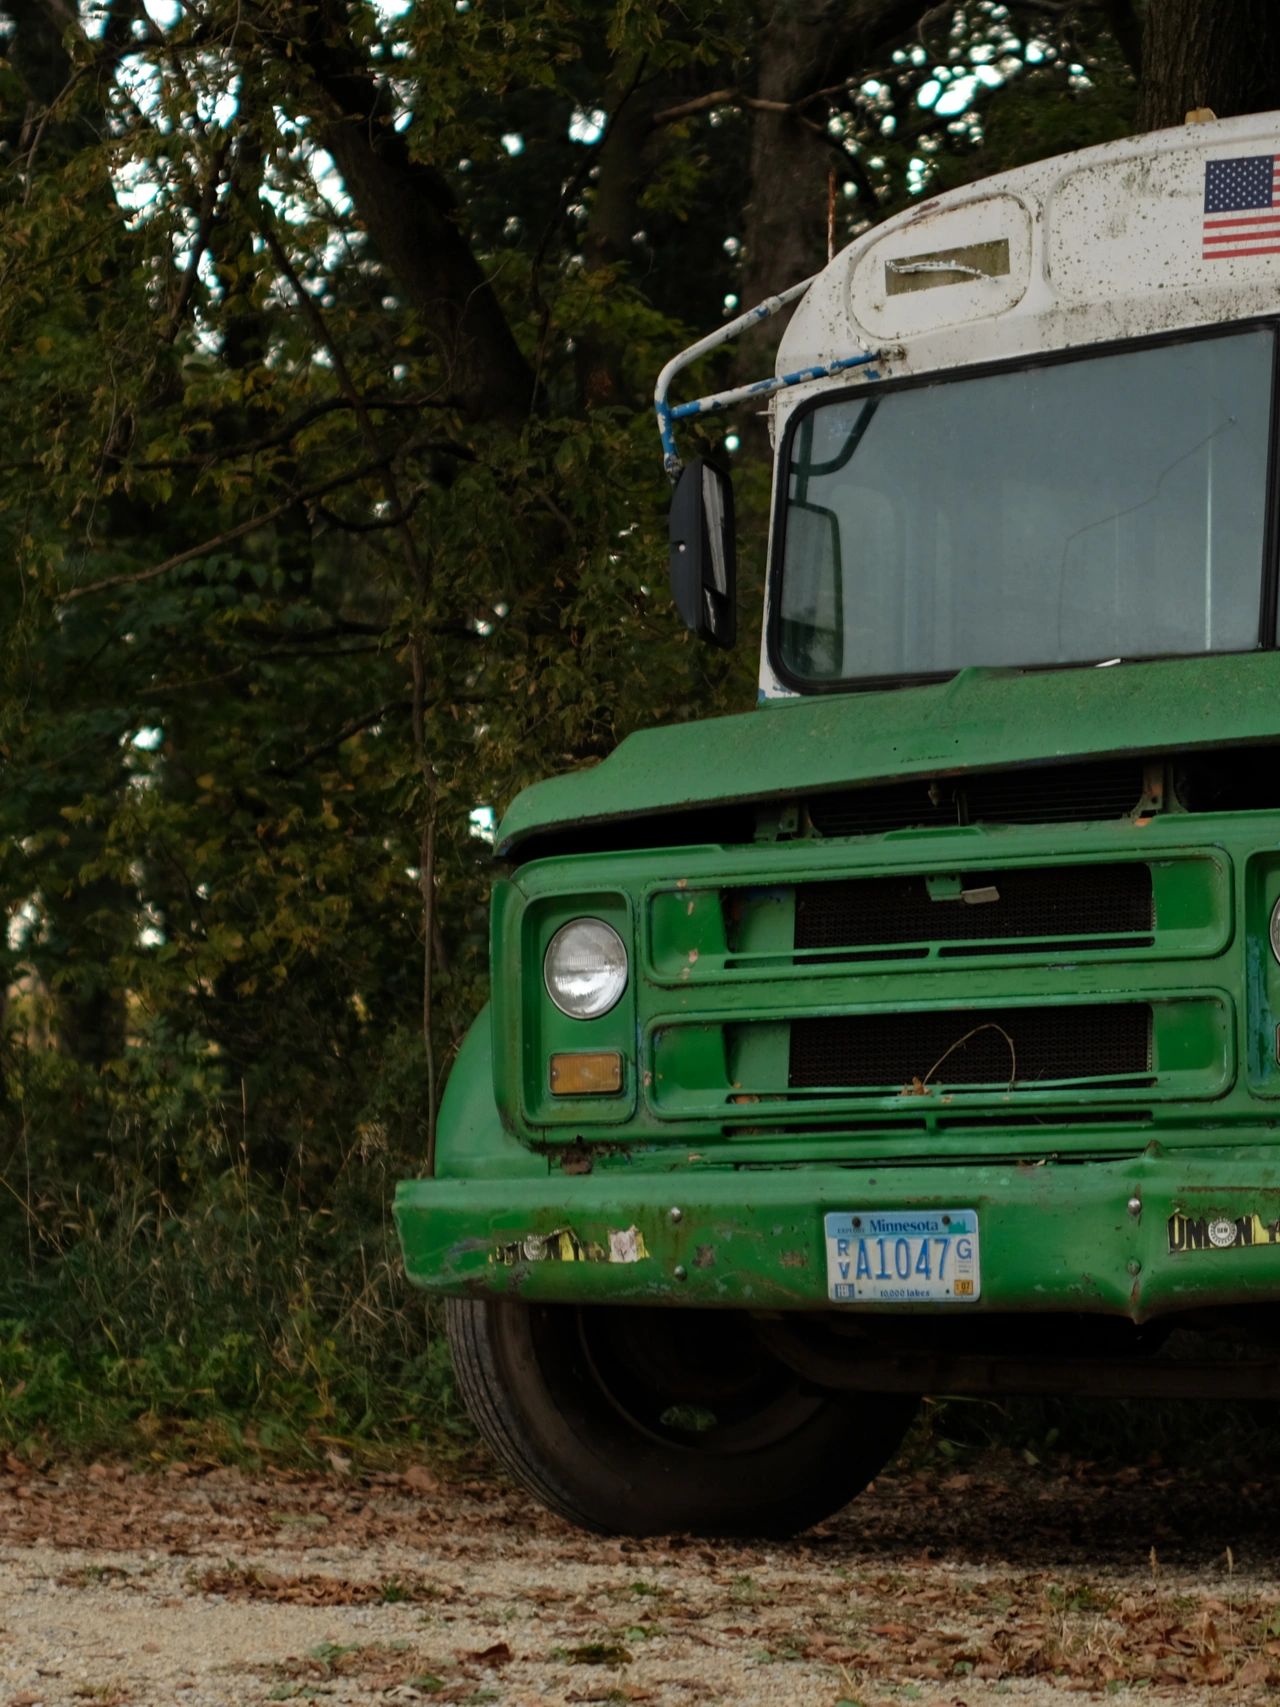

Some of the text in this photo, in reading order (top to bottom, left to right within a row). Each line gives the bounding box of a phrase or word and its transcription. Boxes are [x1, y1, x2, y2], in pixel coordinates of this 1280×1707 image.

[869, 1219, 939, 1233] Minnesota
[956, 1238, 972, 1260] G
[856, 1237, 951, 1281] A1047
[880, 1288, 930, 1298] 10,000 lakes
